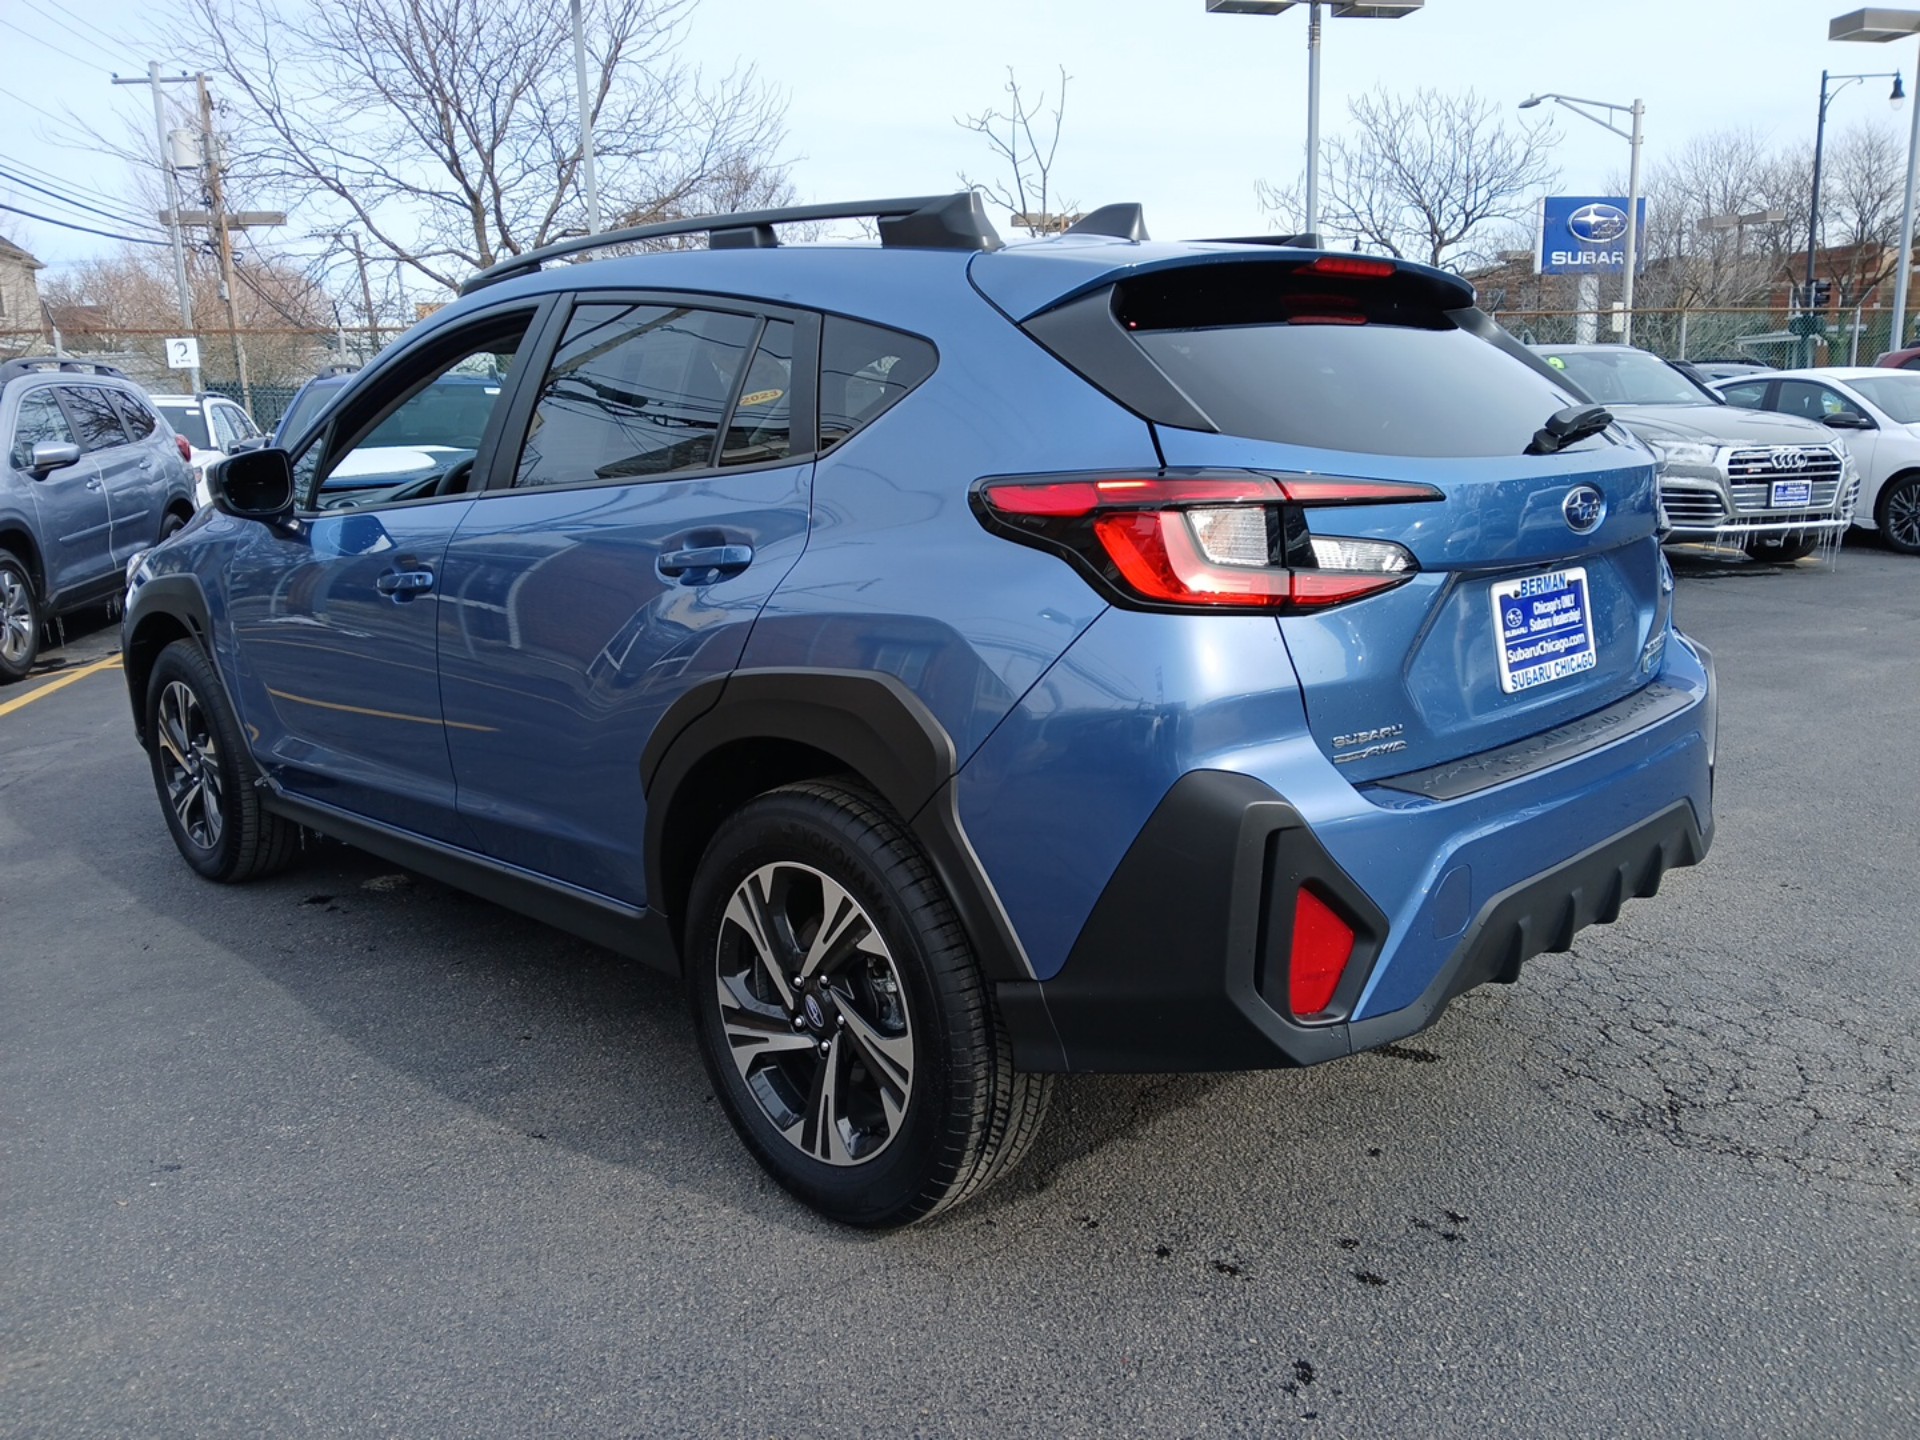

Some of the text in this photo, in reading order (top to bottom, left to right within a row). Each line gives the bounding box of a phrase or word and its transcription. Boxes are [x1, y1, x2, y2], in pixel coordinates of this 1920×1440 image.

[741, 390, 779, 405] 2023
[1520, 572, 1567, 597] BERMAN
[1529, 616, 1553, 632] Subaru
[1507, 633, 1586, 663] SubaruChicago.com
[1511, 652, 1594, 690] SUBARU CHICAGO
[1332, 723, 1403, 748] SUBARU
[799, 826, 891, 922] YOKOHAMA
